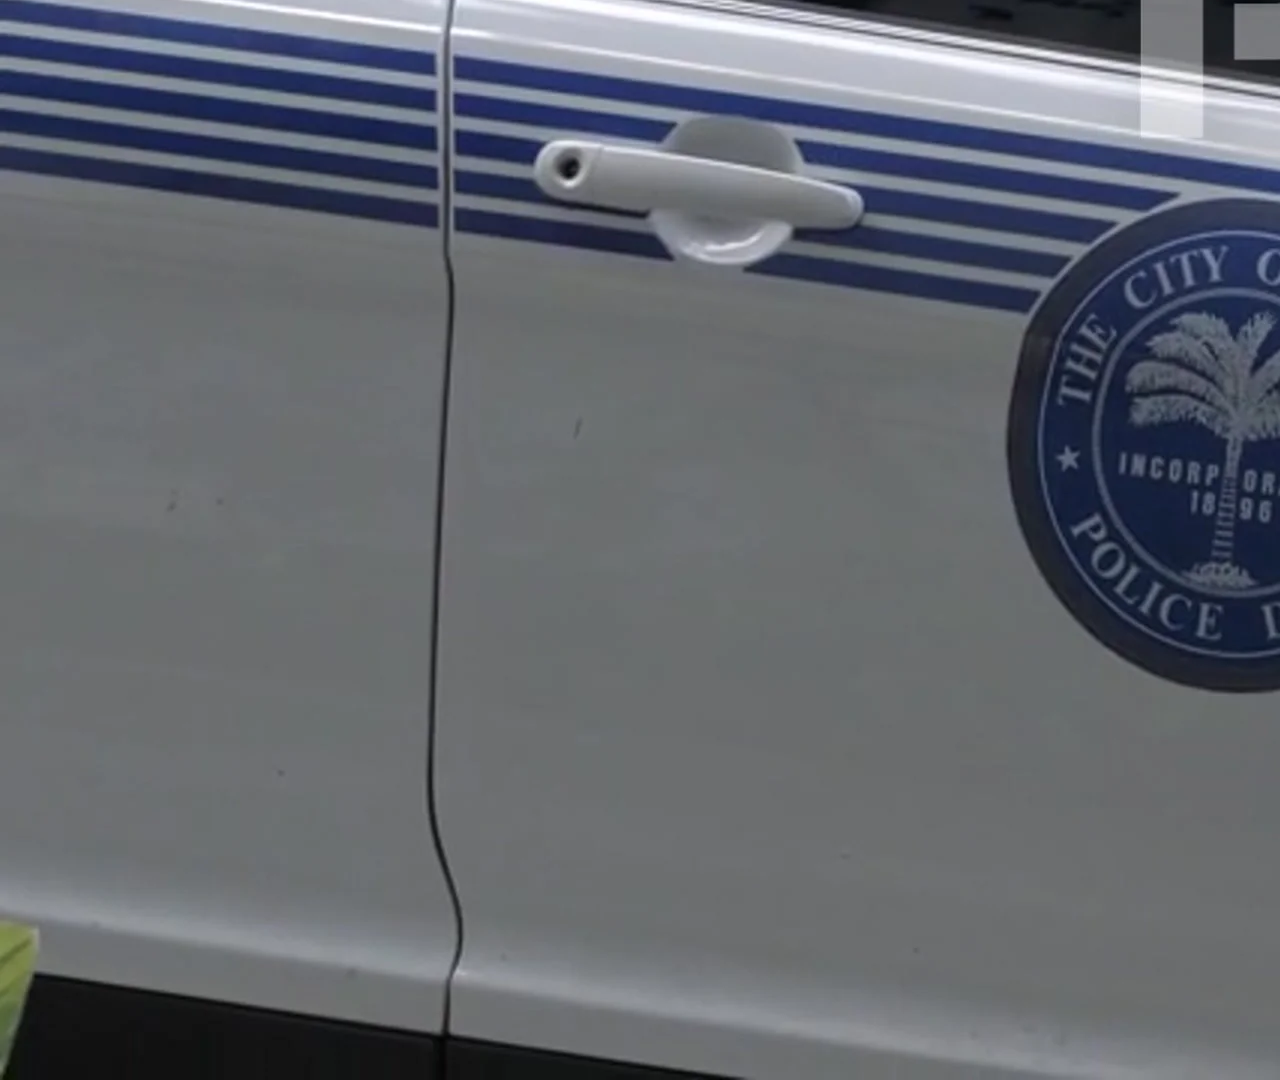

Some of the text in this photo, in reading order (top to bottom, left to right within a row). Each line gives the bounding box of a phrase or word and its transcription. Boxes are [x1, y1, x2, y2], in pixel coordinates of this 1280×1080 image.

[1058, 312, 1119, 406] THE
[1123, 245, 1230, 310] CITY
[1071, 512, 1224, 642] POLICE
